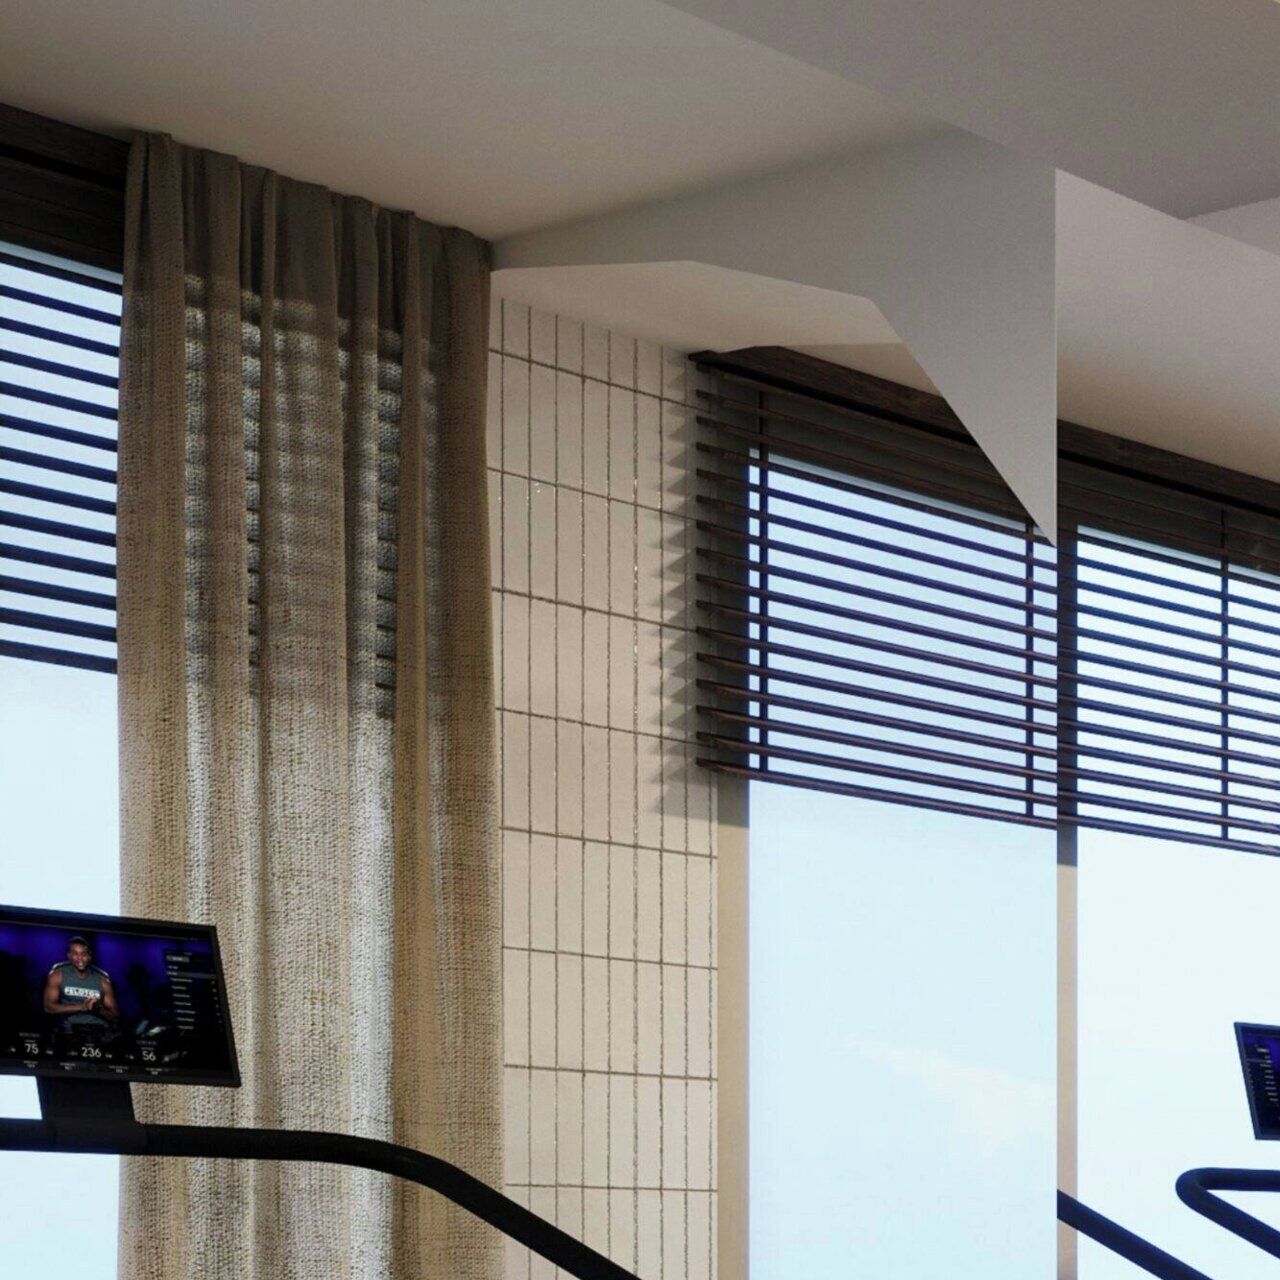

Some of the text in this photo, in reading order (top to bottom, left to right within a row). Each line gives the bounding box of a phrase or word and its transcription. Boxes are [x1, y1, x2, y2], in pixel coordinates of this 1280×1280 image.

[25, 1043, 38, 1055] 75
[81, 1046, 101, 1059] 236
[142, 1050, 156, 1062] 56
